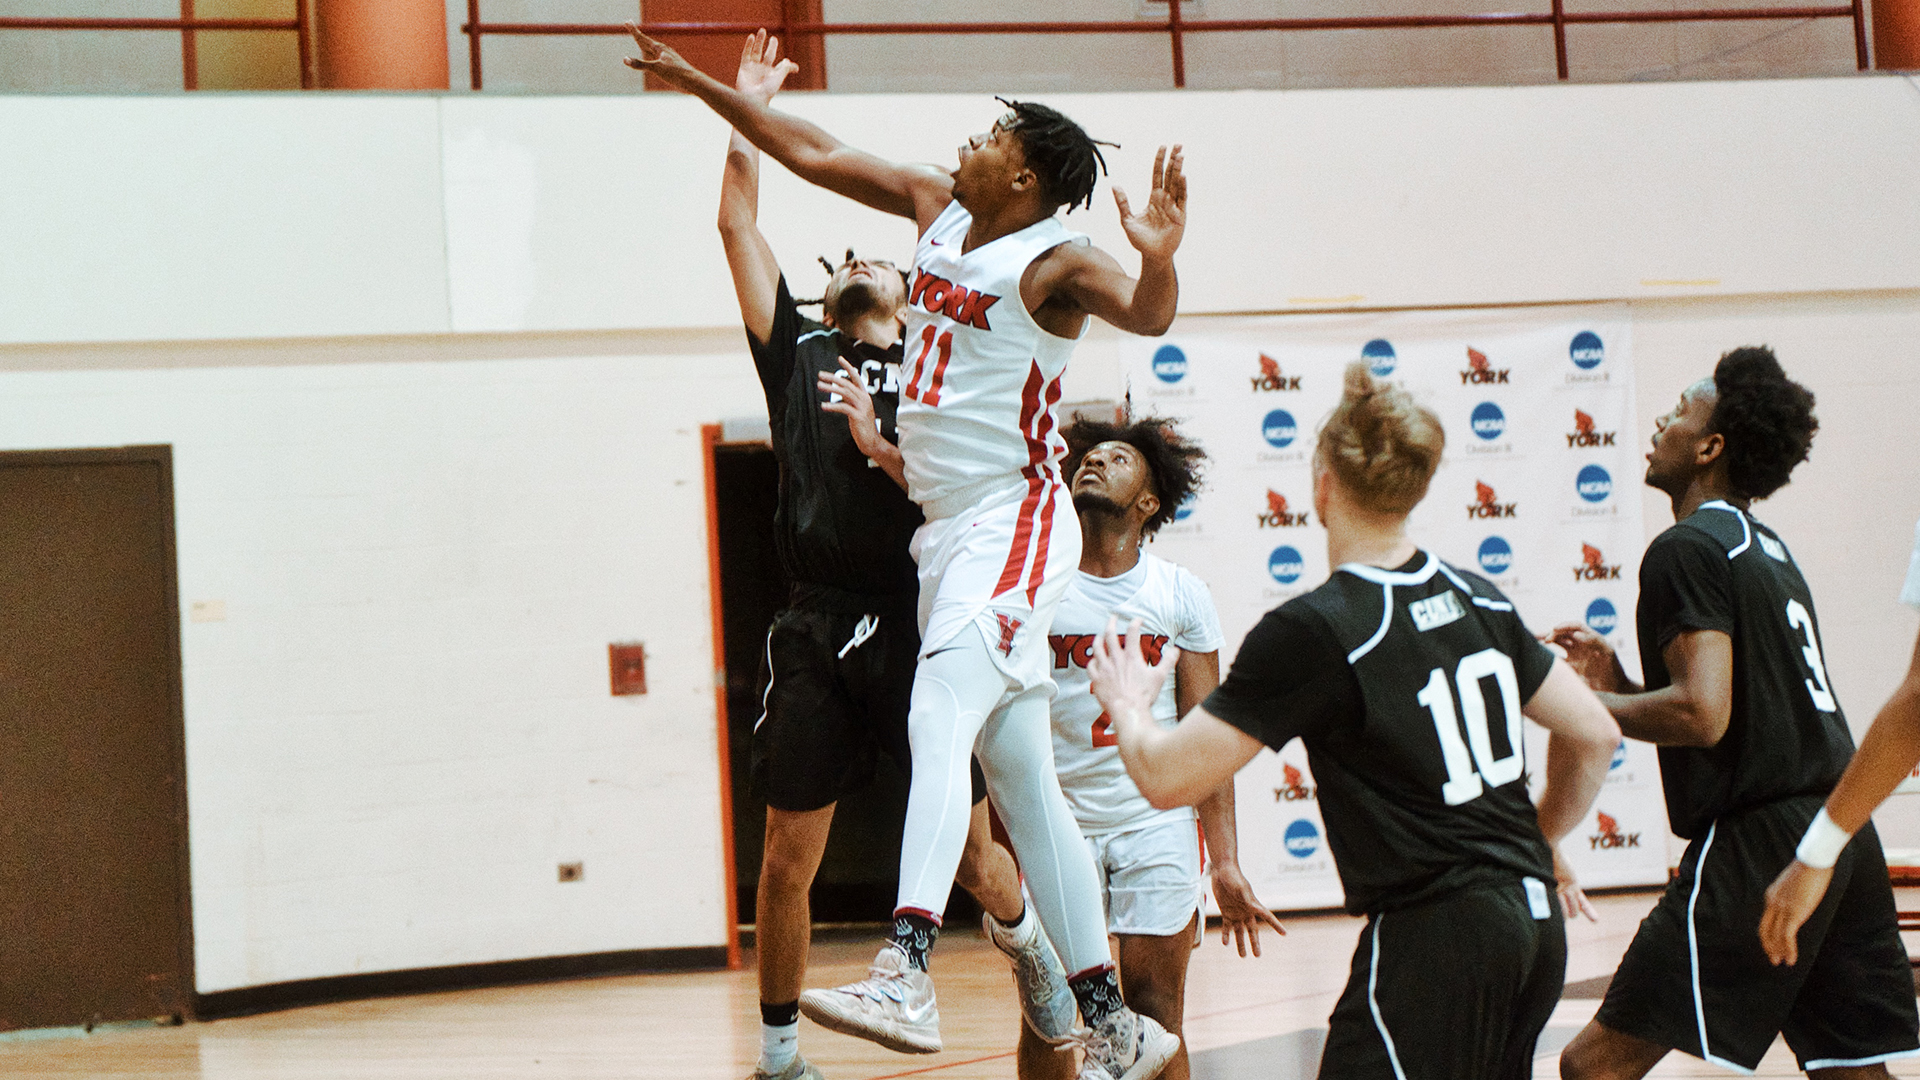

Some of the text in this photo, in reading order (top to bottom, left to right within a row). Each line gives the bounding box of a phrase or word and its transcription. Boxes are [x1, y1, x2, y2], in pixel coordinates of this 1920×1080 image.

[909, 266, 1002, 331] YORK
[905, 324, 953, 407] 11
[1250, 376, 1302, 392] YORK
[1460, 369, 1511, 385] YORK
[1566, 431, 1616, 448] YORK
[1467, 502, 1517, 519] YORK
[1257, 511, 1309, 528] YORK
[1573, 565, 1621, 581] YORK
[1786, 597, 1837, 713] 3
[1416, 647, 1525, 807] 10
[1589, 832, 1641, 849] YORK
